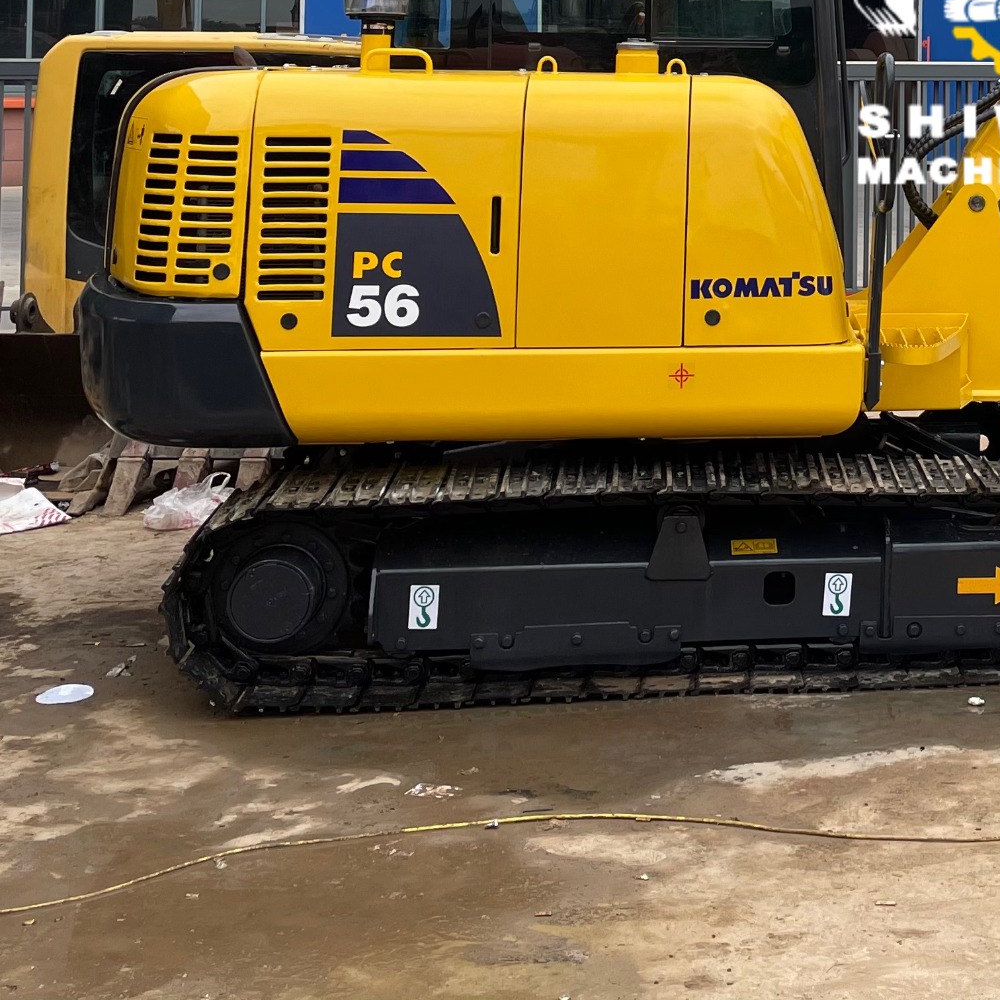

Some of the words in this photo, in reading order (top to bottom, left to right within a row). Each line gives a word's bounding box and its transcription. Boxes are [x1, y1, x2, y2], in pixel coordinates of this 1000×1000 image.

[352, 251, 403, 279] PC
[690, 271, 833, 300] KOMATSU
[346, 284, 420, 328] 56
